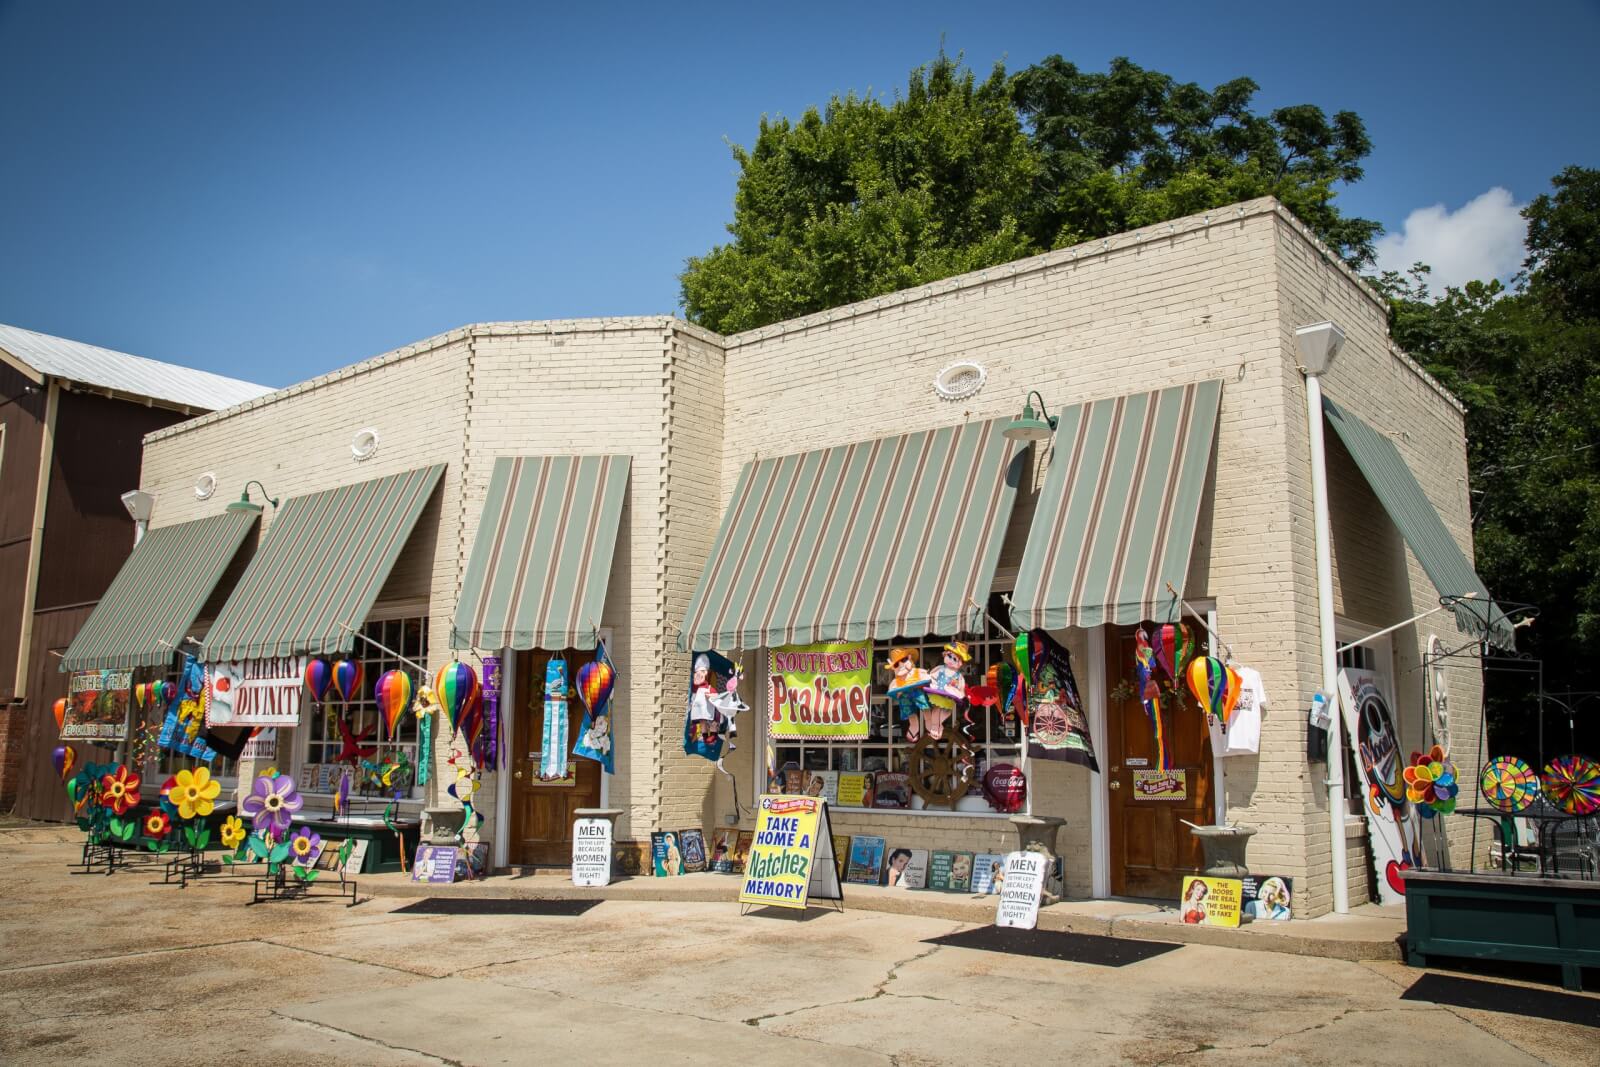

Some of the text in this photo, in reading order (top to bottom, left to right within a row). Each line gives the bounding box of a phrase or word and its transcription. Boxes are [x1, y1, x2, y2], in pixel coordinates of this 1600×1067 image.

[244, 656, 300, 680] CHERRY
[776, 648, 868, 673] SOUTHERN
[237, 685, 303, 715] DIVINITY
[579, 826, 604, 836] MEN
[767, 817, 799, 832] TAKE
[757, 832, 795, 846] HOME
[800, 835, 809, 848] A
[575, 854, 607, 862] WOMEN
[749, 849, 808, 879] Natchez
[1009, 859, 1037, 872] MEN
[745, 880, 803, 899] MEMORY
[1000, 891, 1036, 902] WOMEN
[1219, 903, 1237, 911] SMILE
[1002, 911, 1025, 919] RIGHT!
